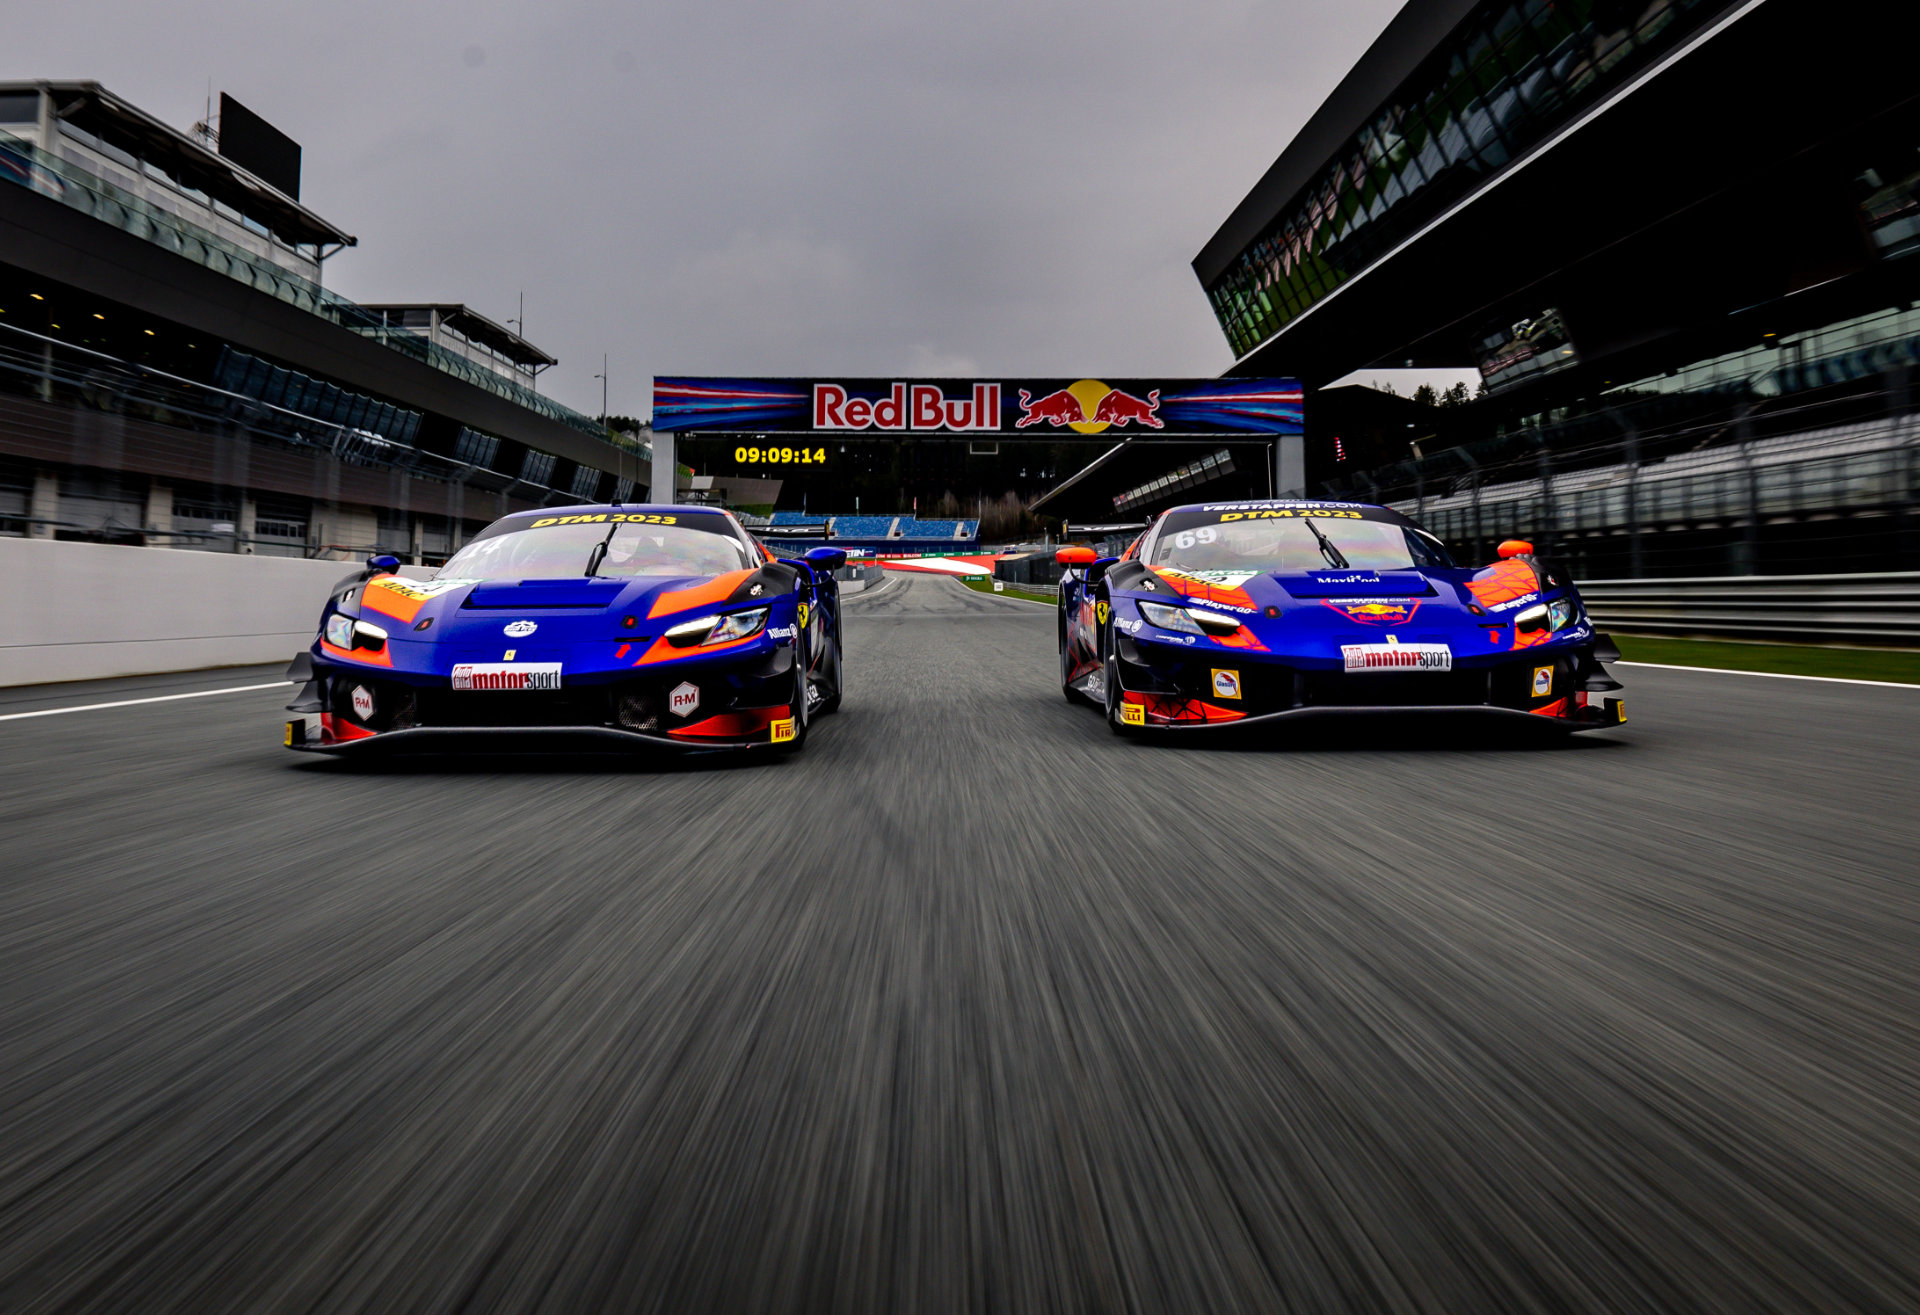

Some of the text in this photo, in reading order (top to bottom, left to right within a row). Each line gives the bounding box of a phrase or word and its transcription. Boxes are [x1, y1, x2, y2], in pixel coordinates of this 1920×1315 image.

[813, 382, 1001, 431] Red Bull
[735, 447, 826, 464] 09:09:14
[1203, 503, 1363, 512] VERSTAPPEN.COM
[530, 514, 677, 528] DTM 2023
[1220, 510, 1363, 522] DTM 2023
[1175, 527, 1217, 549] 69
[767, 626, 791, 640] Allianz
[1364, 650, 1450, 670] motorsport
[472, 670, 560, 690] motorsport
[355, 696, 370, 708] R-M
[674, 693, 697, 706] R-M
